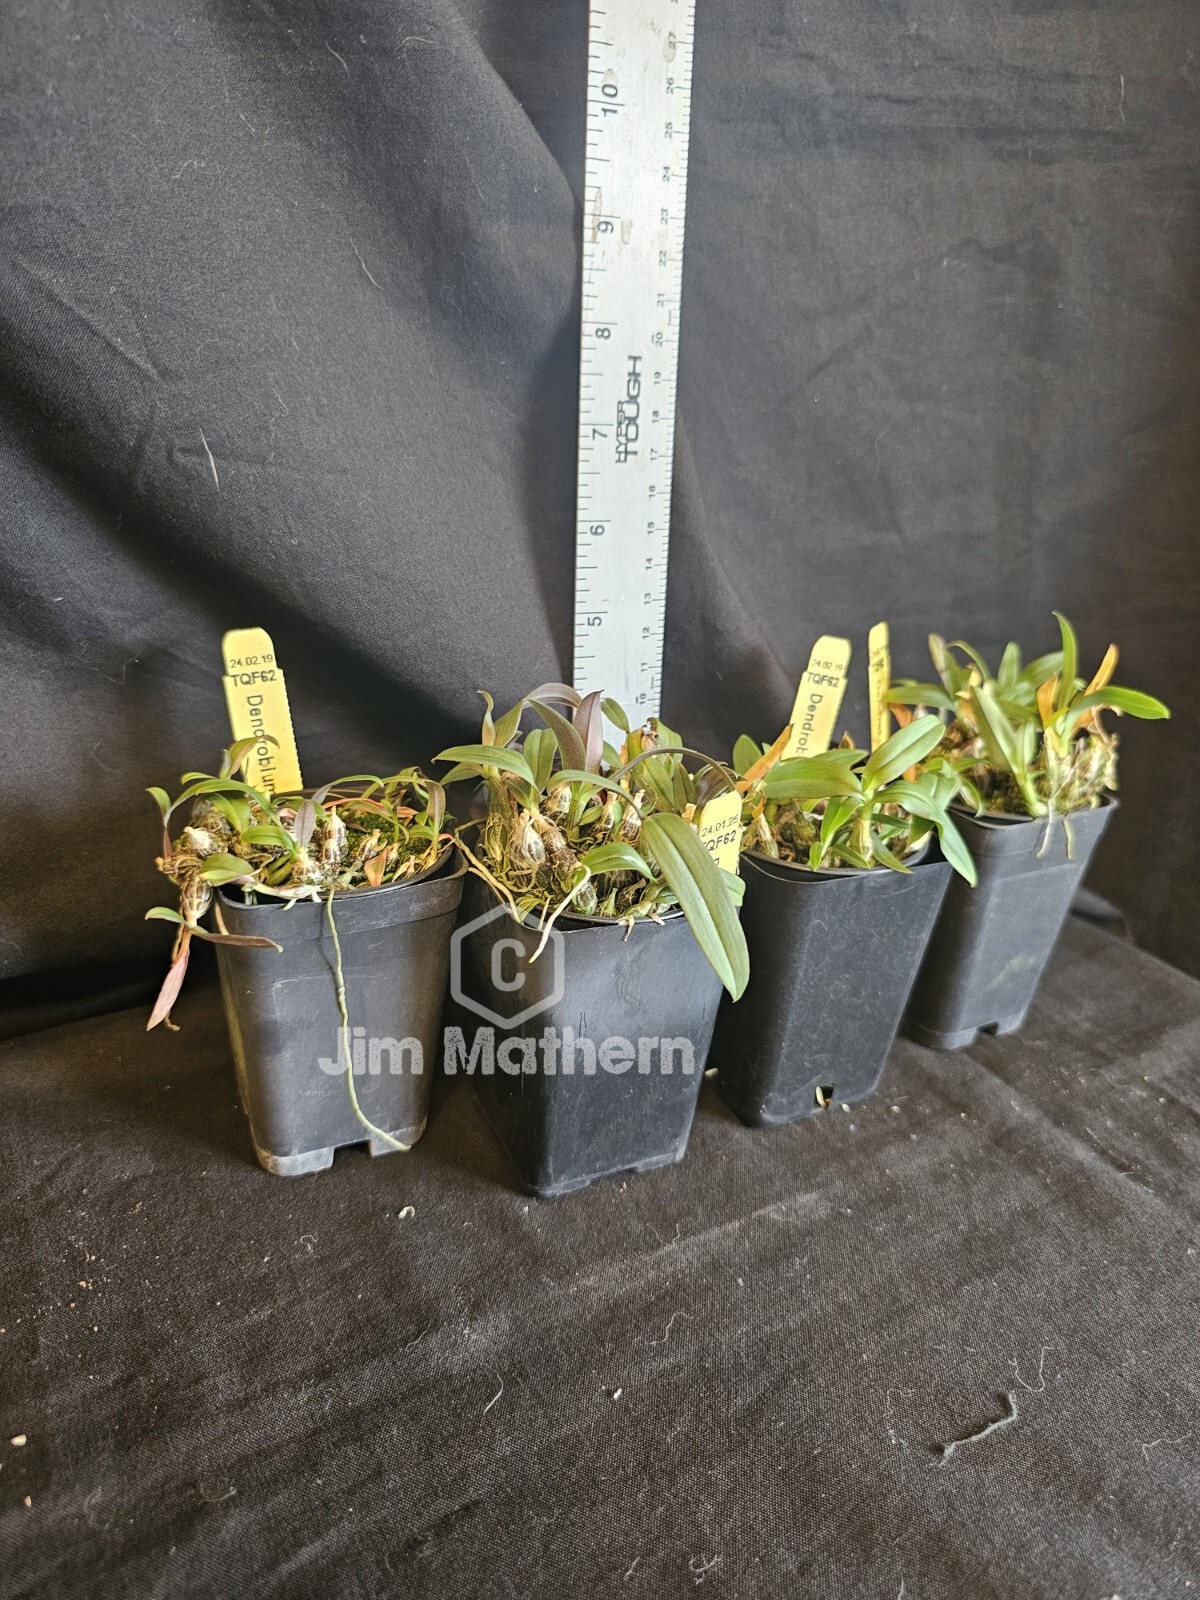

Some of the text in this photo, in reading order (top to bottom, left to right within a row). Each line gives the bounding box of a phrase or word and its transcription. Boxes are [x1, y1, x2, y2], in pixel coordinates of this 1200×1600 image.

[666, 77, 674, 95] 26
[602, 84, 618, 117] 10
[663, 166, 671, 182] 24
[598, 221, 614, 234] 9
[659, 251, 667, 266] 22
[657, 293, 665, 307] 21
[596, 327, 611, 340] 8
[655, 332, 664, 347] 20
[654, 371, 661, 385] 19
[626, 356, 642, 456] TOUGH
[652, 411, 660, 424] 18
[593, 429, 608, 440] 7
[651, 449, 658, 461] 17
[649, 486, 656, 499] 16
[590, 525, 604, 536] 6
[647, 522, 655, 535] 15
[646, 558, 653, 570] 14
[644, 593, 651, 605] 13
[588, 617, 602, 626] 5
[642, 627, 650, 639] 12
[230, 654, 274, 669] 24.02.19
[641, 662, 648, 672] 11
[231, 669, 277, 687] TQF62
[807, 672, 839, 688] TQF62
[639, 693, 647, 705] 10
[701, 814, 739, 838] 24.01.25
